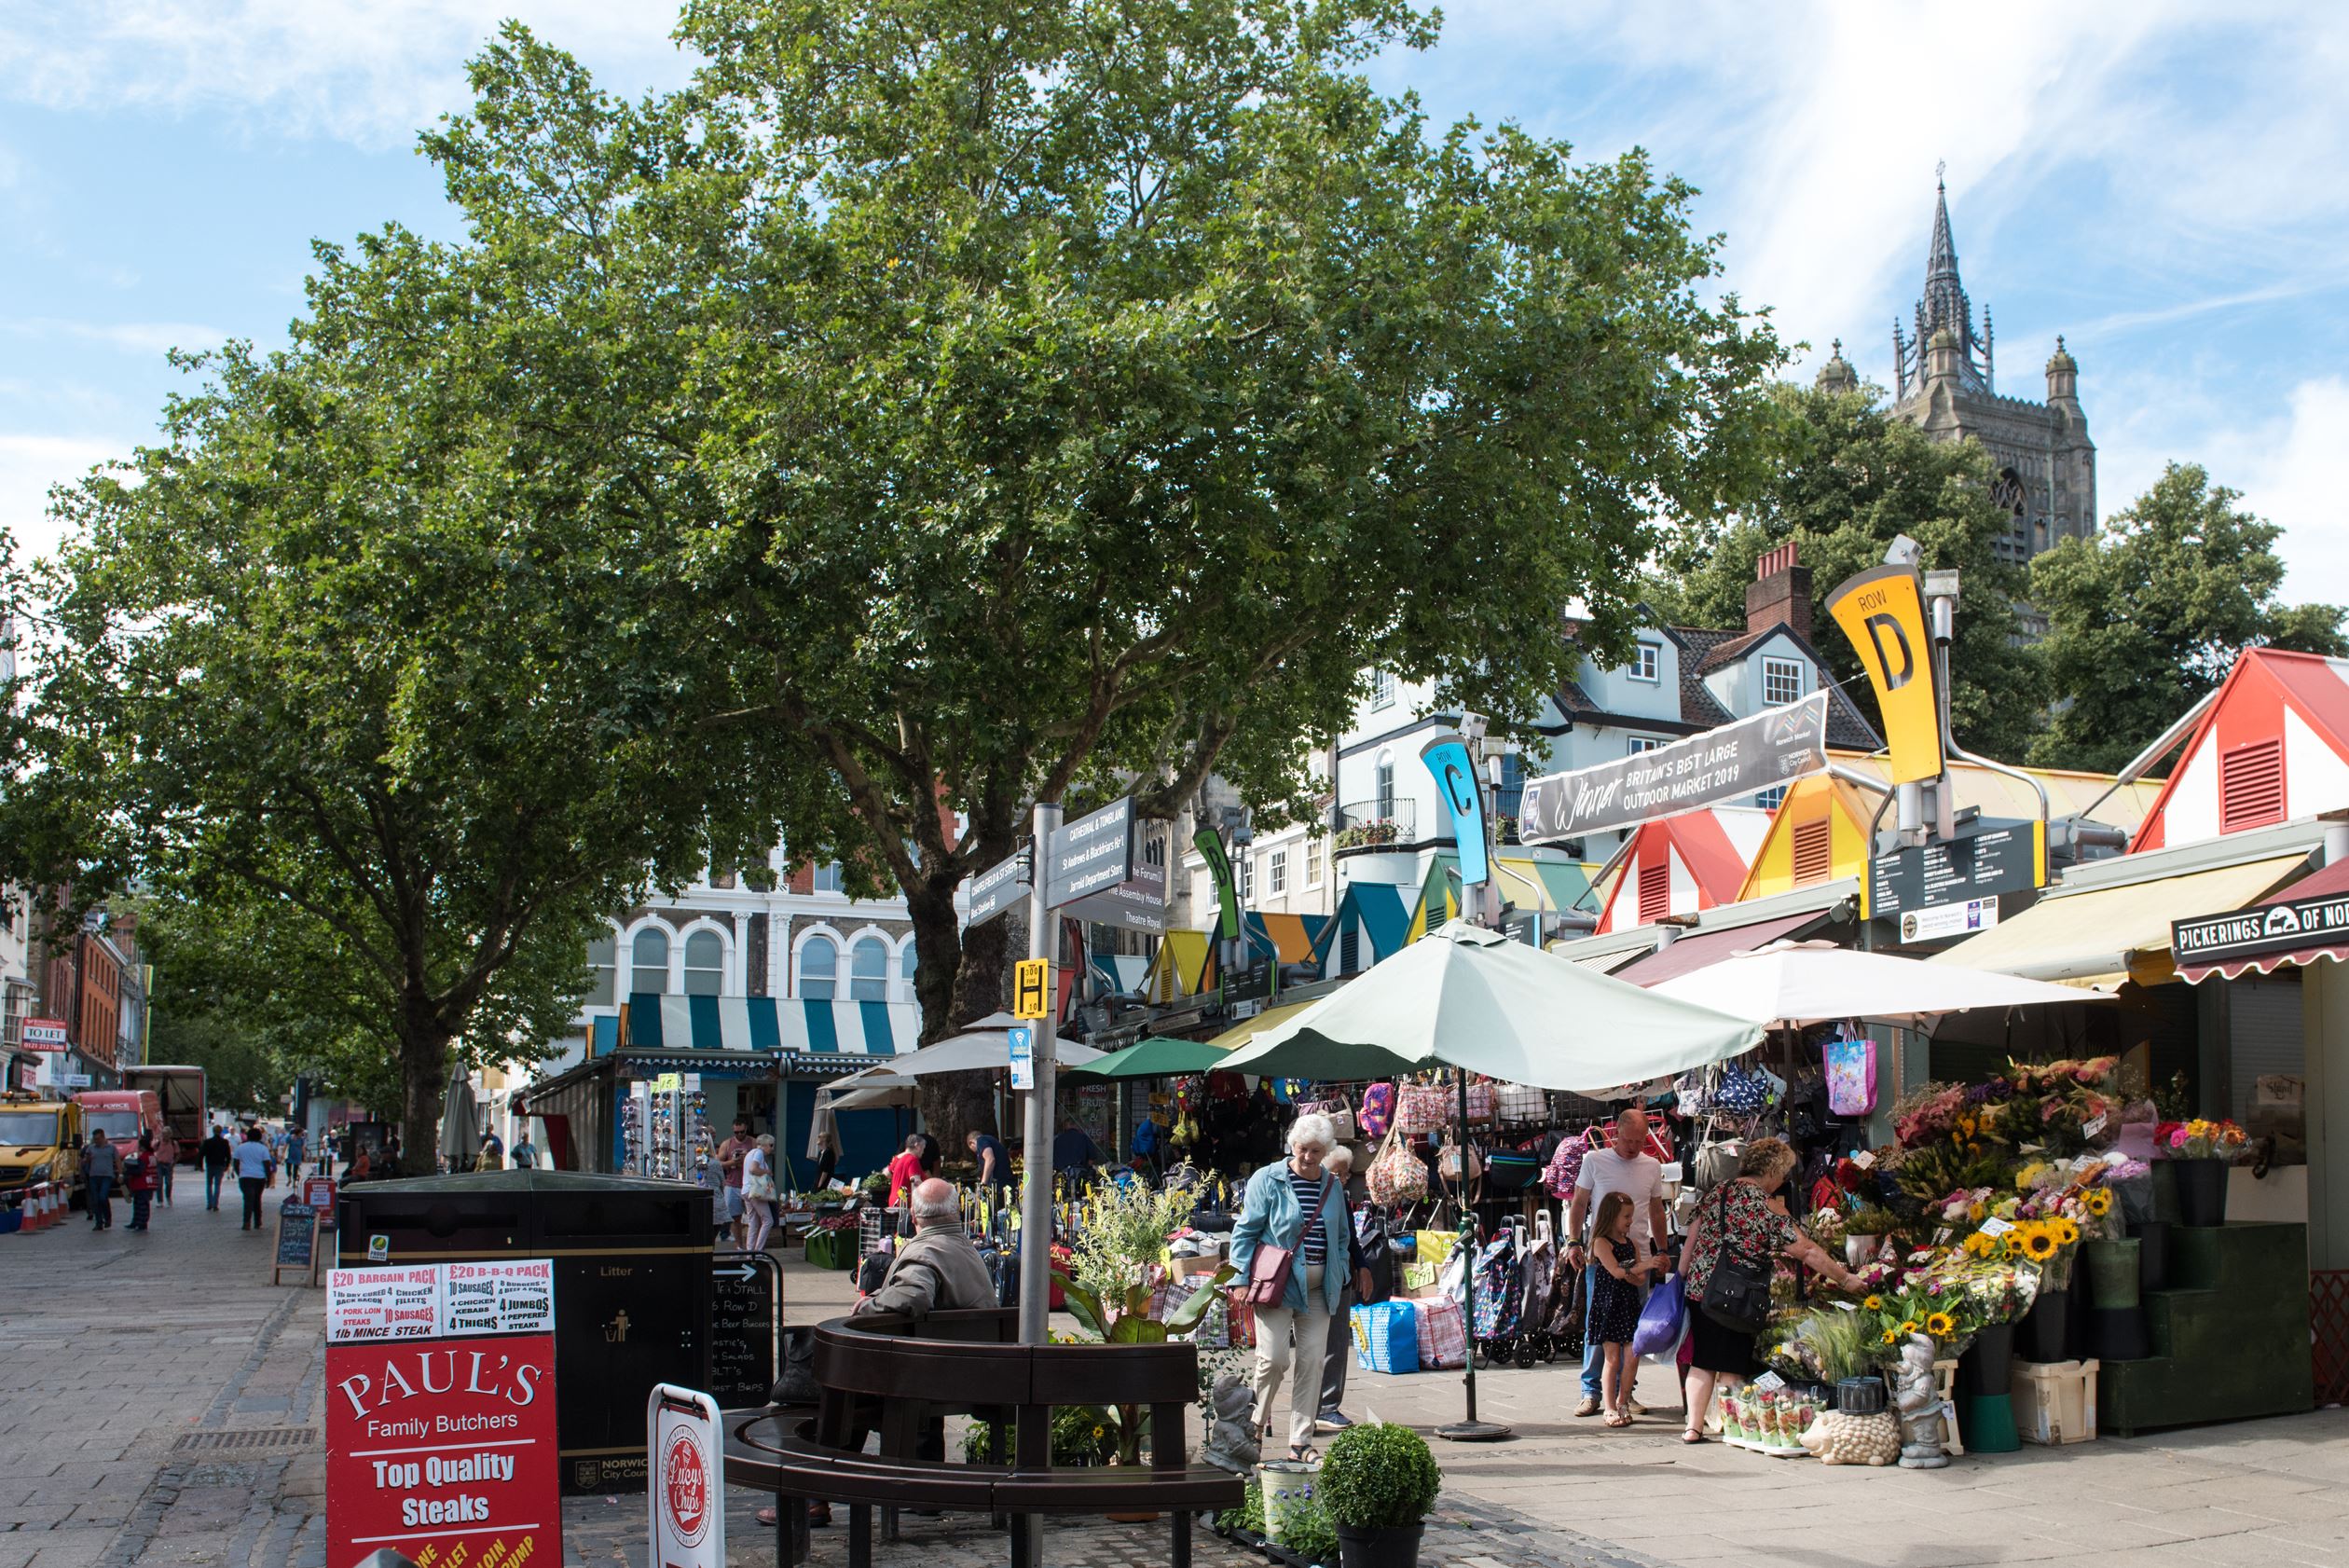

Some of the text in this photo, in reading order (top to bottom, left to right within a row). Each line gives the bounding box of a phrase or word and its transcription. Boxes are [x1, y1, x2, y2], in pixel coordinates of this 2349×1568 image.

[1858, 589, 1887, 612] ROW
[1864, 613, 1914, 692] D
[1776, 730, 1811, 746] Norwich Market
[1436, 750, 1452, 764] ROW
[1626, 741, 1738, 788] BRITAIN'S BEST LARGE
[1445, 764, 1471, 817] C
[1624, 764, 1739, 811] OUTDOOR MARKET 2019
[1555, 777, 1622, 831] Winner
[1070, 806, 1125, 841] CATHEDRAL & TOMBLAND
[1068, 854, 1085, 867] Andrews
[1086, 849, 1089, 861] &
[1207, 846, 1227, 887] B
[1086, 868, 1110, 887] Department
[1111, 865, 1123, 877] Store
[1141, 868, 1157, 881] Forum
[972, 874, 995, 897] CHAPELFIELD
[1119, 887, 1145, 904] Assembly
[1146, 893, 1162, 906] House
[978, 901, 990, 915] Station
[1126, 911, 1161, 930] Theatre Royal
[2178, 919, 2260, 949] PICKERINGS
[2302, 908, 2320, 930] OF
[1026, 967, 1038, 976] 300
[1020, 965, 1042, 1013] H
[1090, 1113, 1098, 1121] &
[1085, 1128, 1102, 1137] VEG
[333, 1268, 436, 1288] £20 BARGAIN PACK
[450, 1264, 549, 1279] £20 B-B-Q PACK
[601, 1266, 632, 1276] Litter
[388, 1286, 433, 1296] 4 CHICKEN
[449, 1280, 494, 1296] 10 SAUSAGES
[734, 1280, 766, 1294] STALL
[500, 1297, 549, 1312] 4 JUMBOS
[723, 1301, 744, 1311] ROW
[748, 1301, 757, 1311] D
[385, 1306, 433, 1324] 10 SAUSAGES
[450, 1316, 497, 1330] 4 THIGHS
[508, 1312, 548, 1320] PEPPERED
[353, 1327, 390, 1338] MINCE
[395, 1326, 433, 1336] STEAK
[337, 1350, 542, 1421] PAUL'S
[367, 1413, 518, 1438] Family Butchers
[373, 1452, 515, 1489] Top Quality
[602, 1458, 648, 1469] NORWIC
[602, 1470, 648, 1481] City Coun
[669, 1454, 702, 1495] Lucys
[675, 1485, 699, 1513] Chips
[402, 1494, 489, 1526] Steaks
